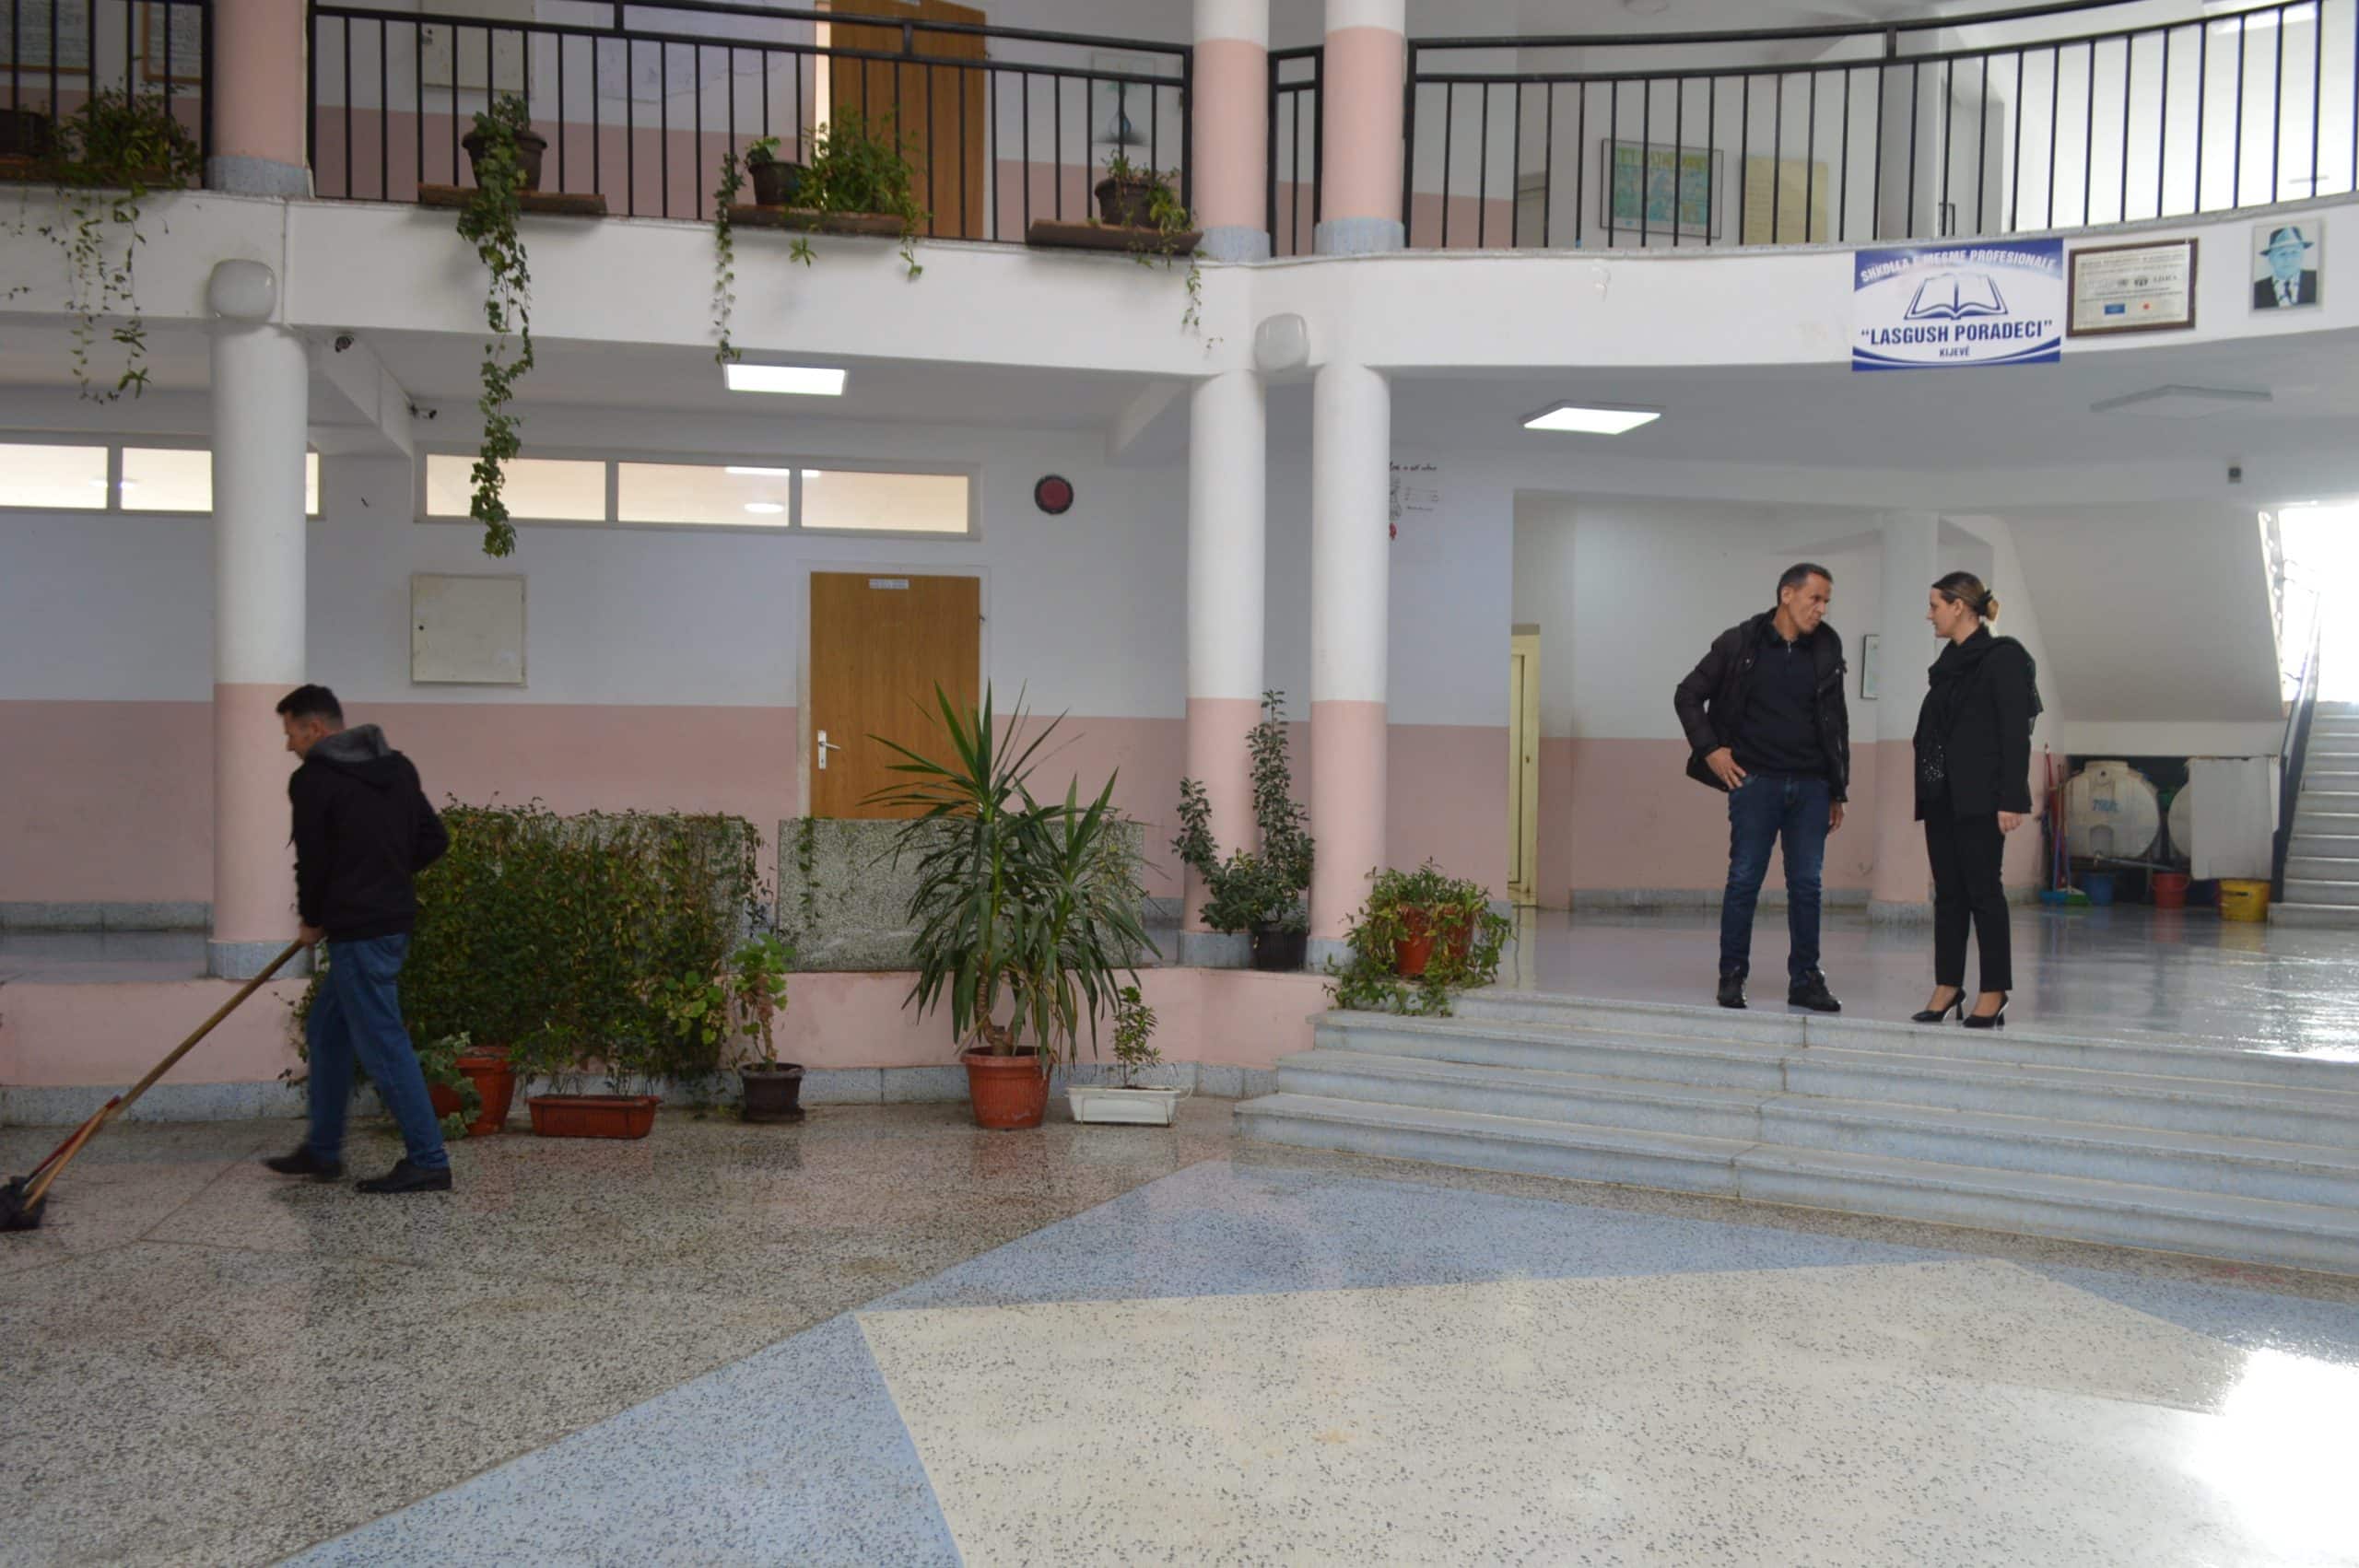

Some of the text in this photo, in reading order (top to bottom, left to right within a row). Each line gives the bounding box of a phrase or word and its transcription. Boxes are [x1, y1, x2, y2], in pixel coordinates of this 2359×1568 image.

[1860, 257, 1909, 282] SHKOLLA
[1923, 250, 1967, 263] MESME
[1969, 250, 2057, 270] PROFESIONALE
